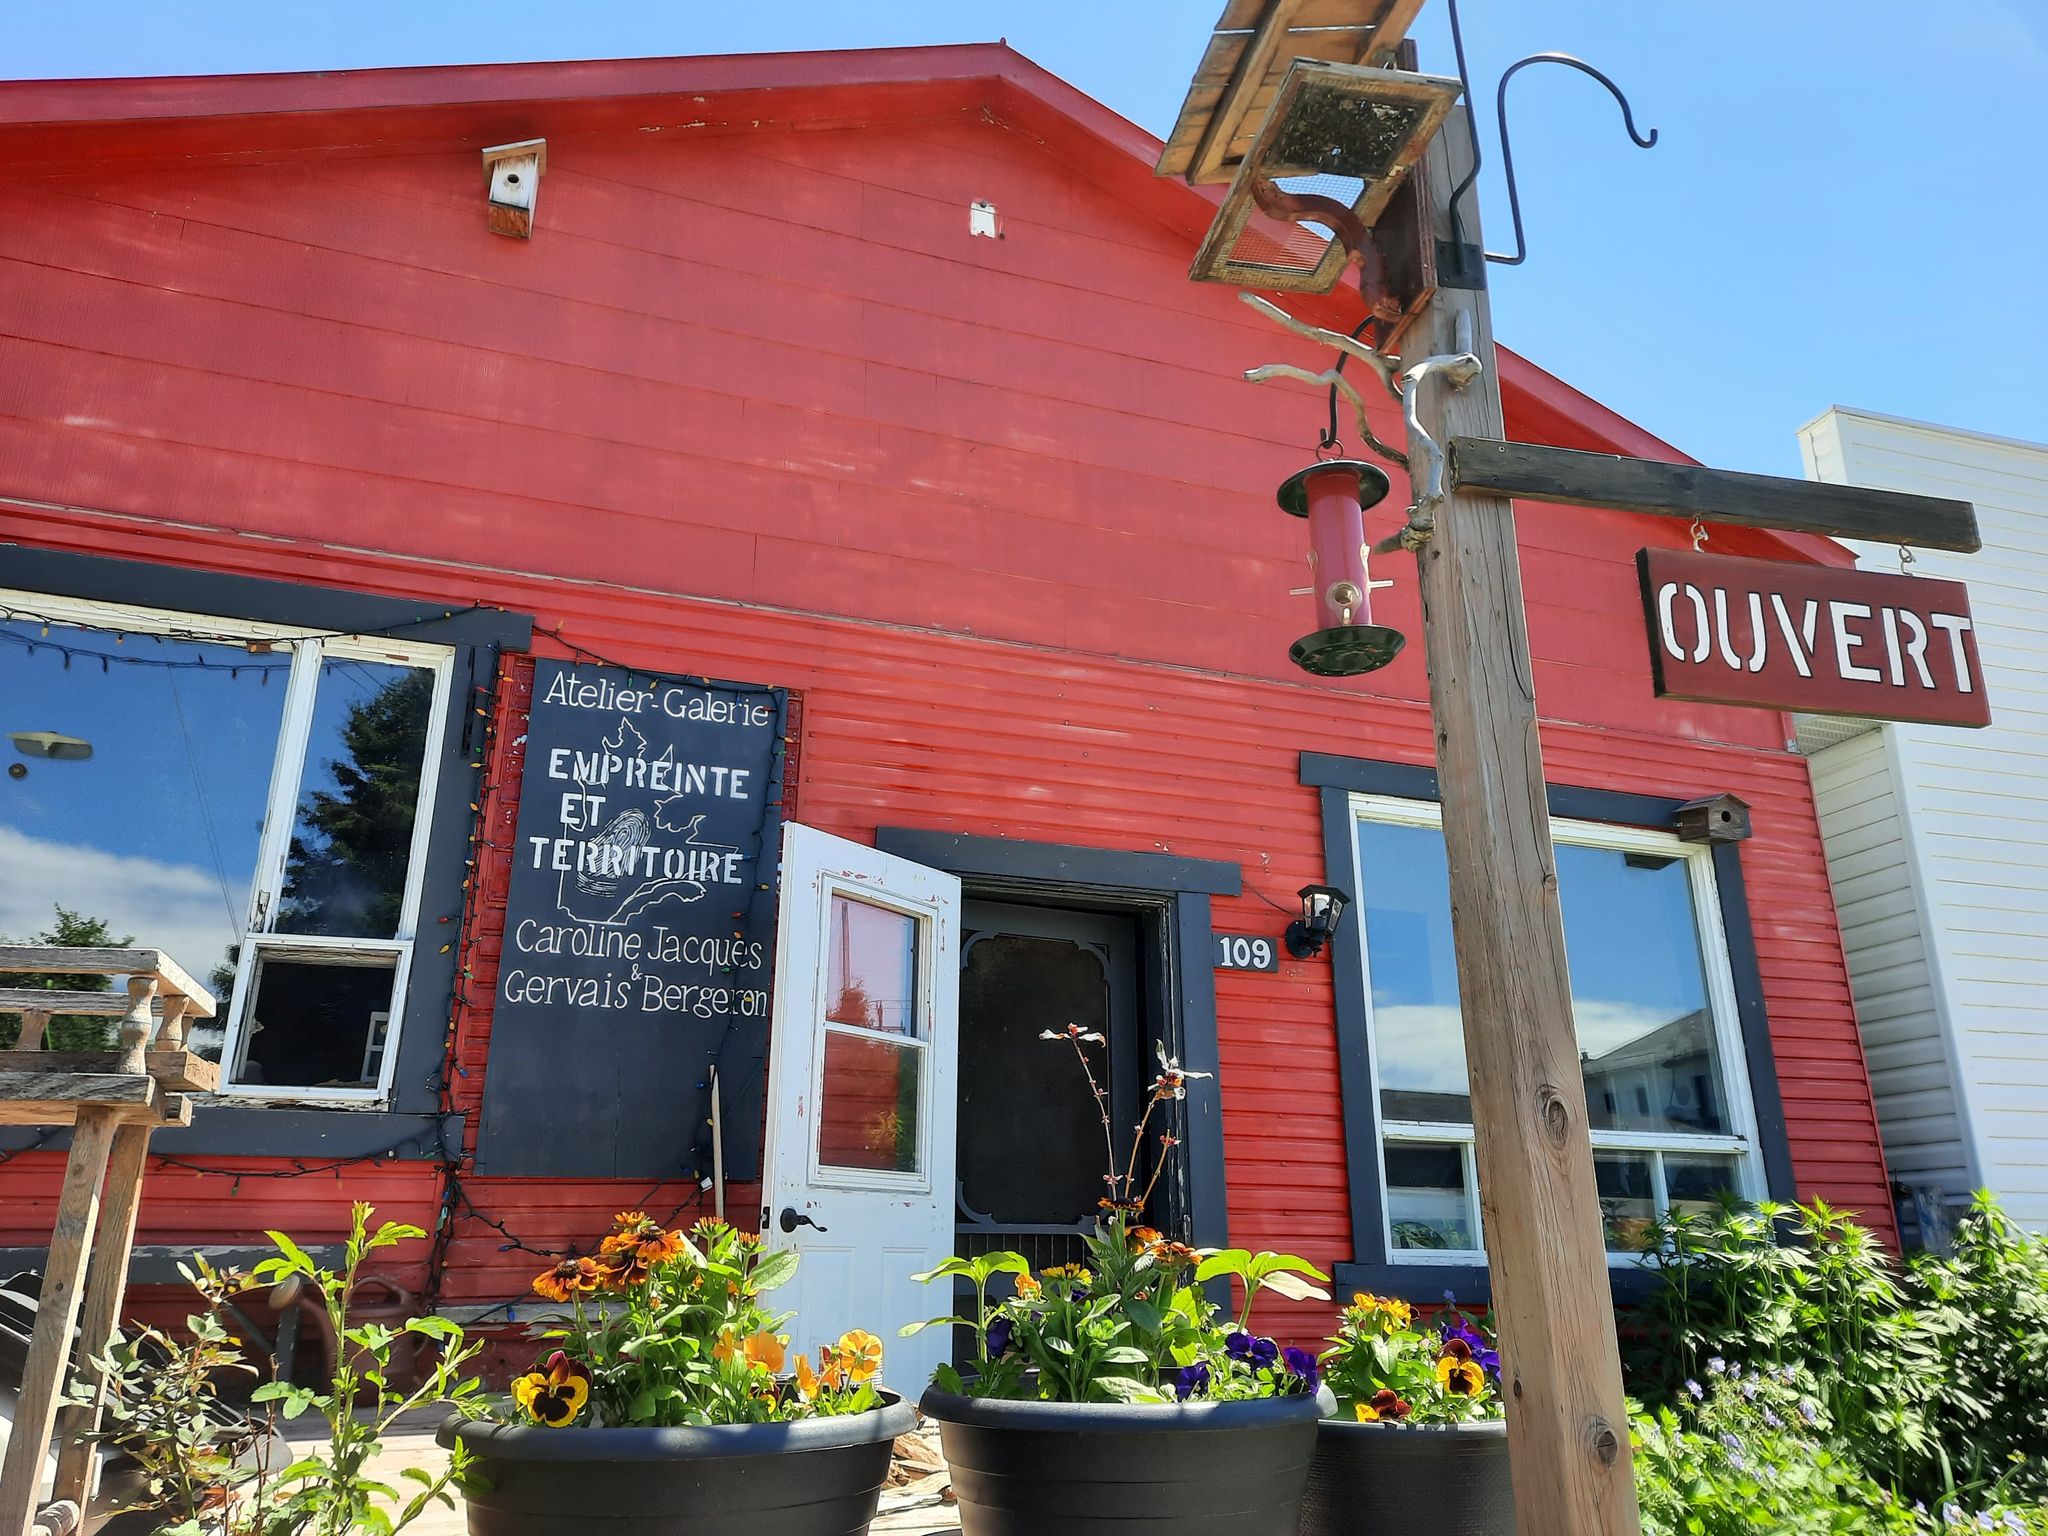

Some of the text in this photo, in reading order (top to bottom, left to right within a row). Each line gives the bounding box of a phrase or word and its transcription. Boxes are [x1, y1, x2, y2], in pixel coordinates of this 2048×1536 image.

[1658, 582, 1973, 693] OUVERT
[542, 670, 769, 726] Atelier-Galerie
[548, 748, 750, 799] EMPREINTE
[560, 792, 606, 827] ET
[529, 836, 744, 884] TERRITOIRE
[515, 919, 763, 977] Caroline Jacques
[631, 963, 643, 981] &
[1219, 937, 1271, 969] 109
[504, 970, 768, 1019] Gervais Bergeron
